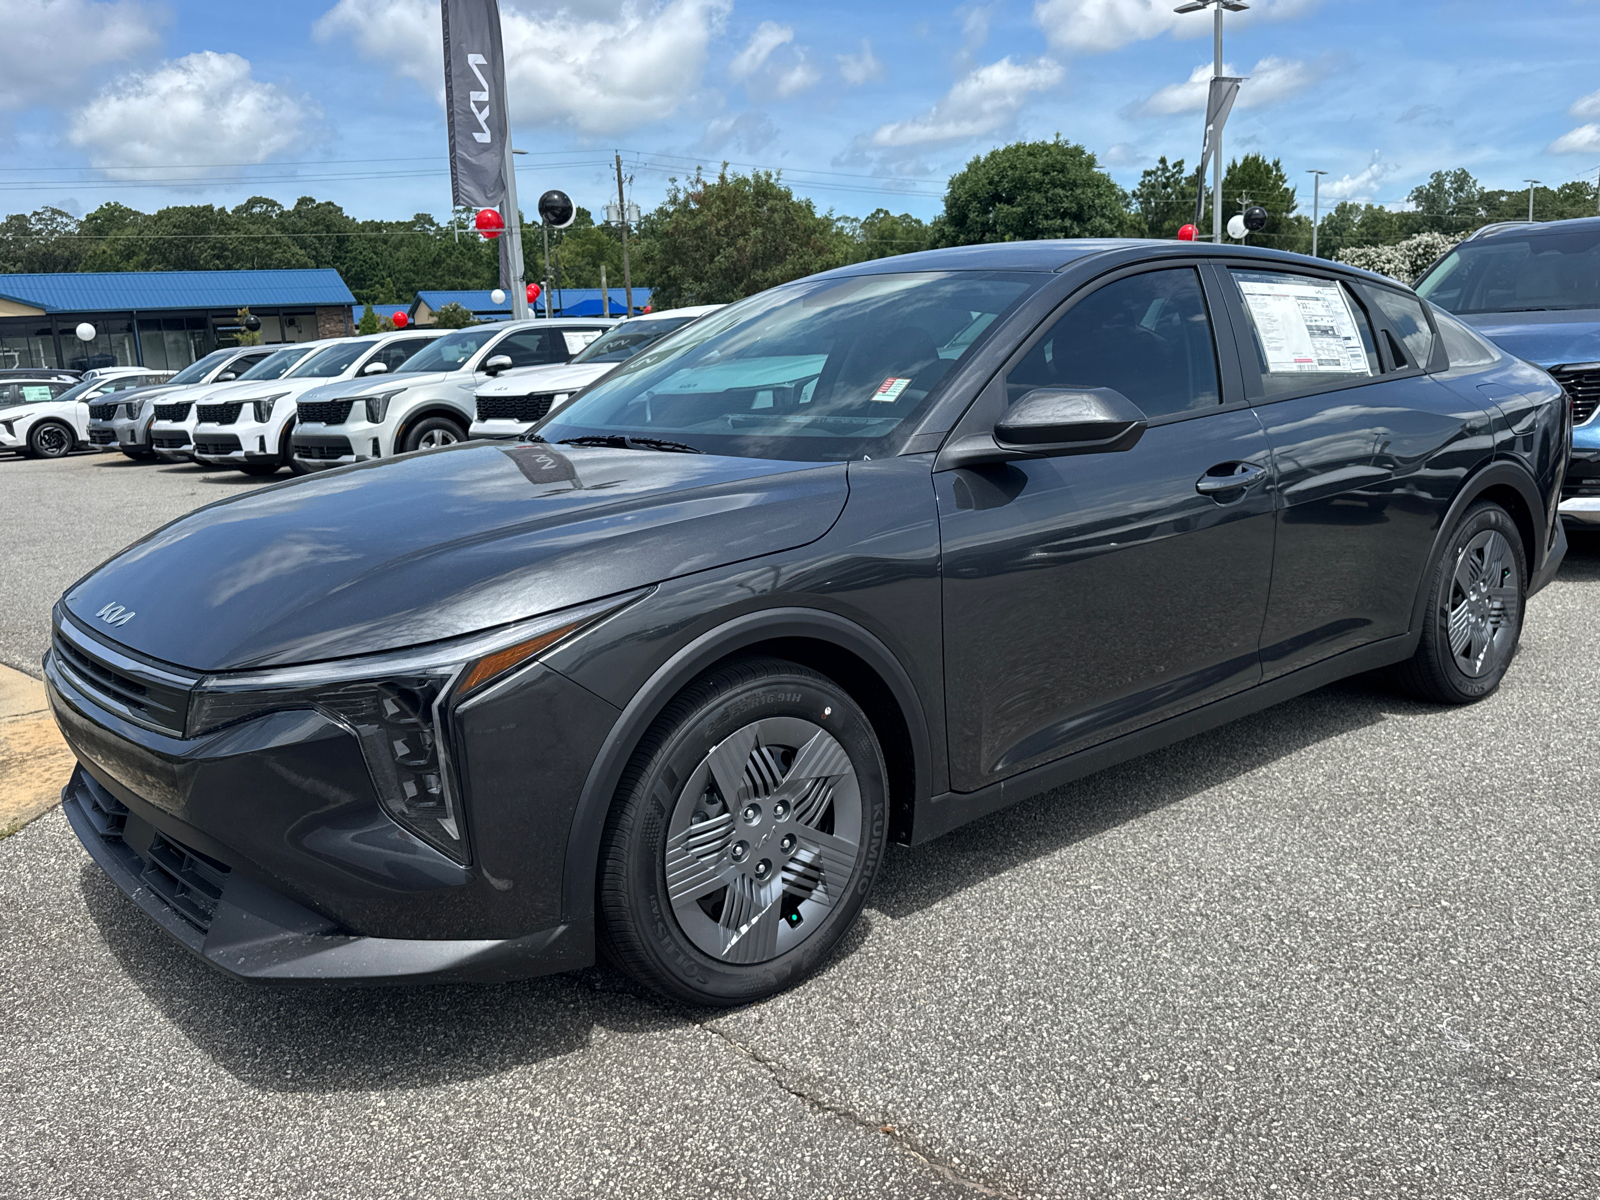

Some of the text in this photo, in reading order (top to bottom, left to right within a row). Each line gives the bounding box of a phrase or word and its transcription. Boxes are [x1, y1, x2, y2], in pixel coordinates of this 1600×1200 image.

[467, 53, 491, 143] KIA
[95, 601, 136, 628] KIA
[777, 692, 802, 702] 91H
[857, 802, 884, 895] KUMHO
[652, 921, 712, 985] SOLUS
